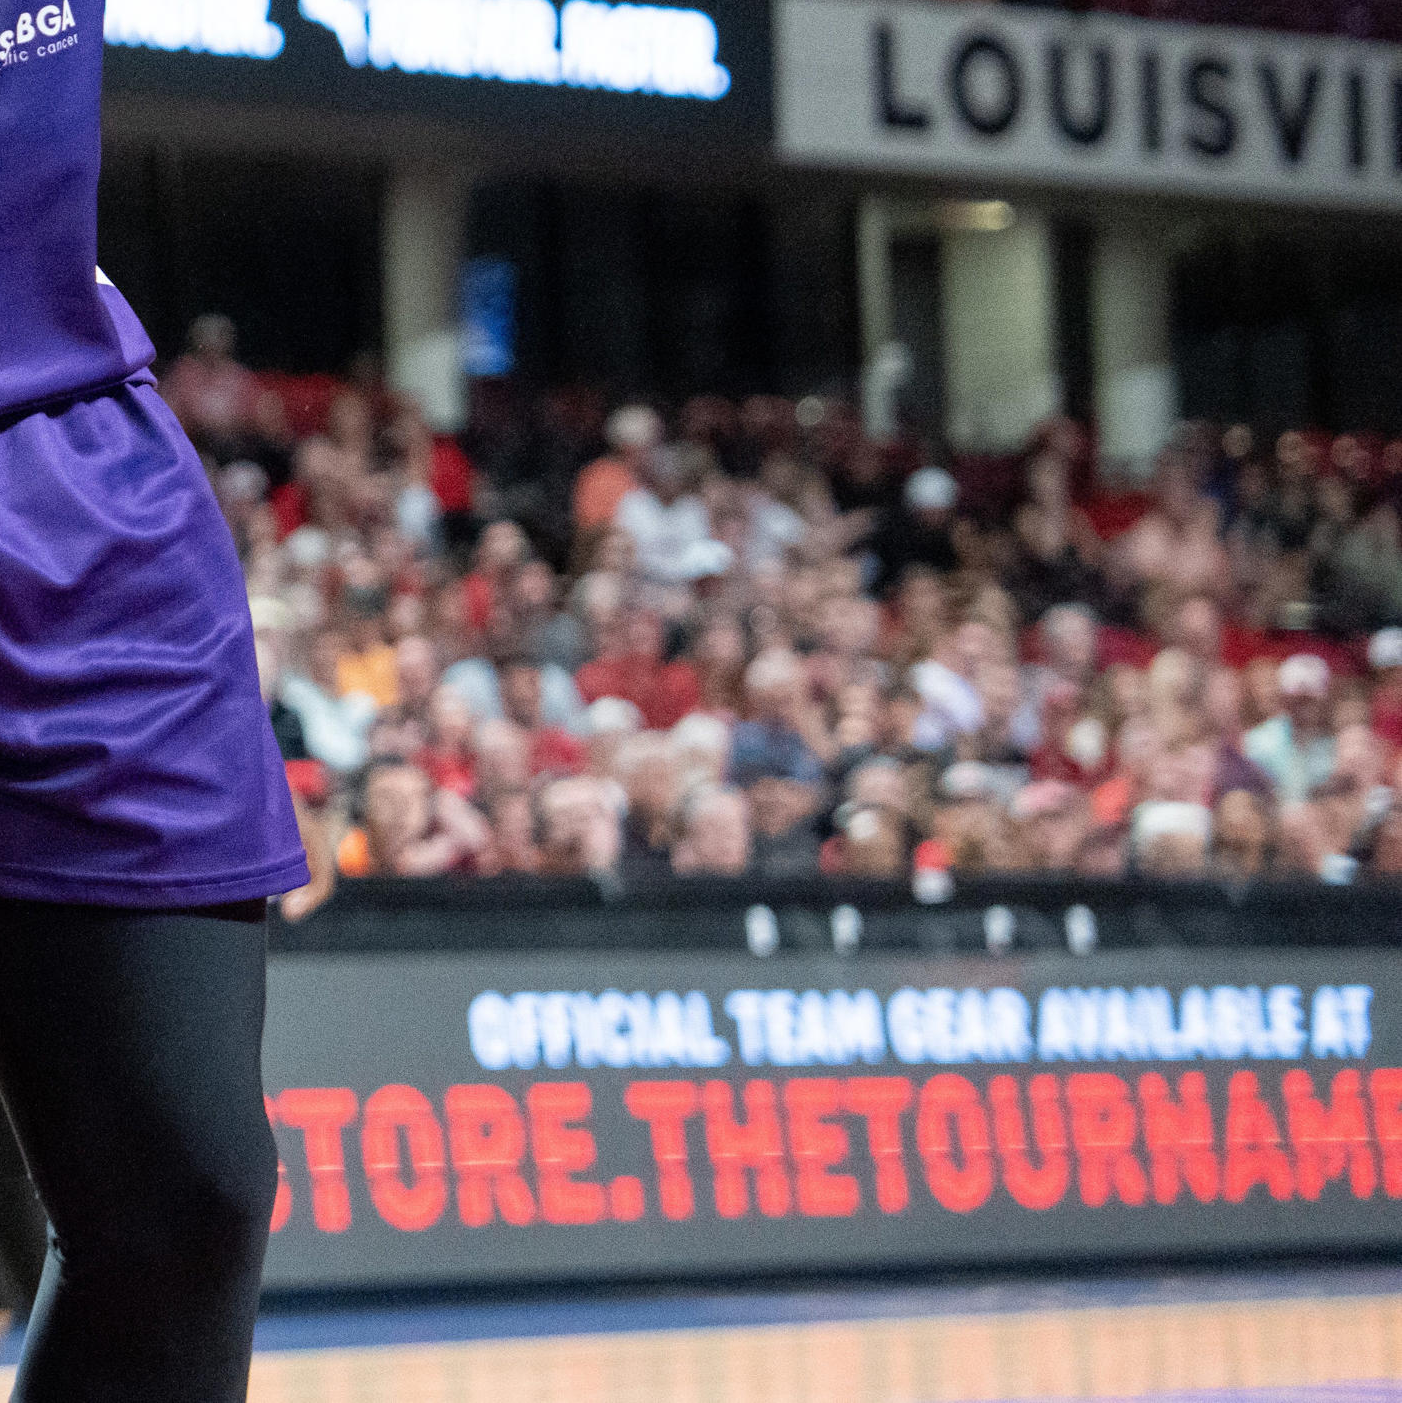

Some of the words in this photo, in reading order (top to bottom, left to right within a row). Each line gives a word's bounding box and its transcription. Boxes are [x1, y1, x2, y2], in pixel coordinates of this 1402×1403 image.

[36, 32, 79, 58] cancer
[873, 18, 1402, 175] LOUISVI
[467, 987, 732, 1071] OFFICIAL
[723, 986, 887, 1069] TEAM
[887, 986, 1035, 1066] GEAR
[1035, 984, 1306, 1064] AVAILABLE
[1307, 984, 1375, 1061] AT
